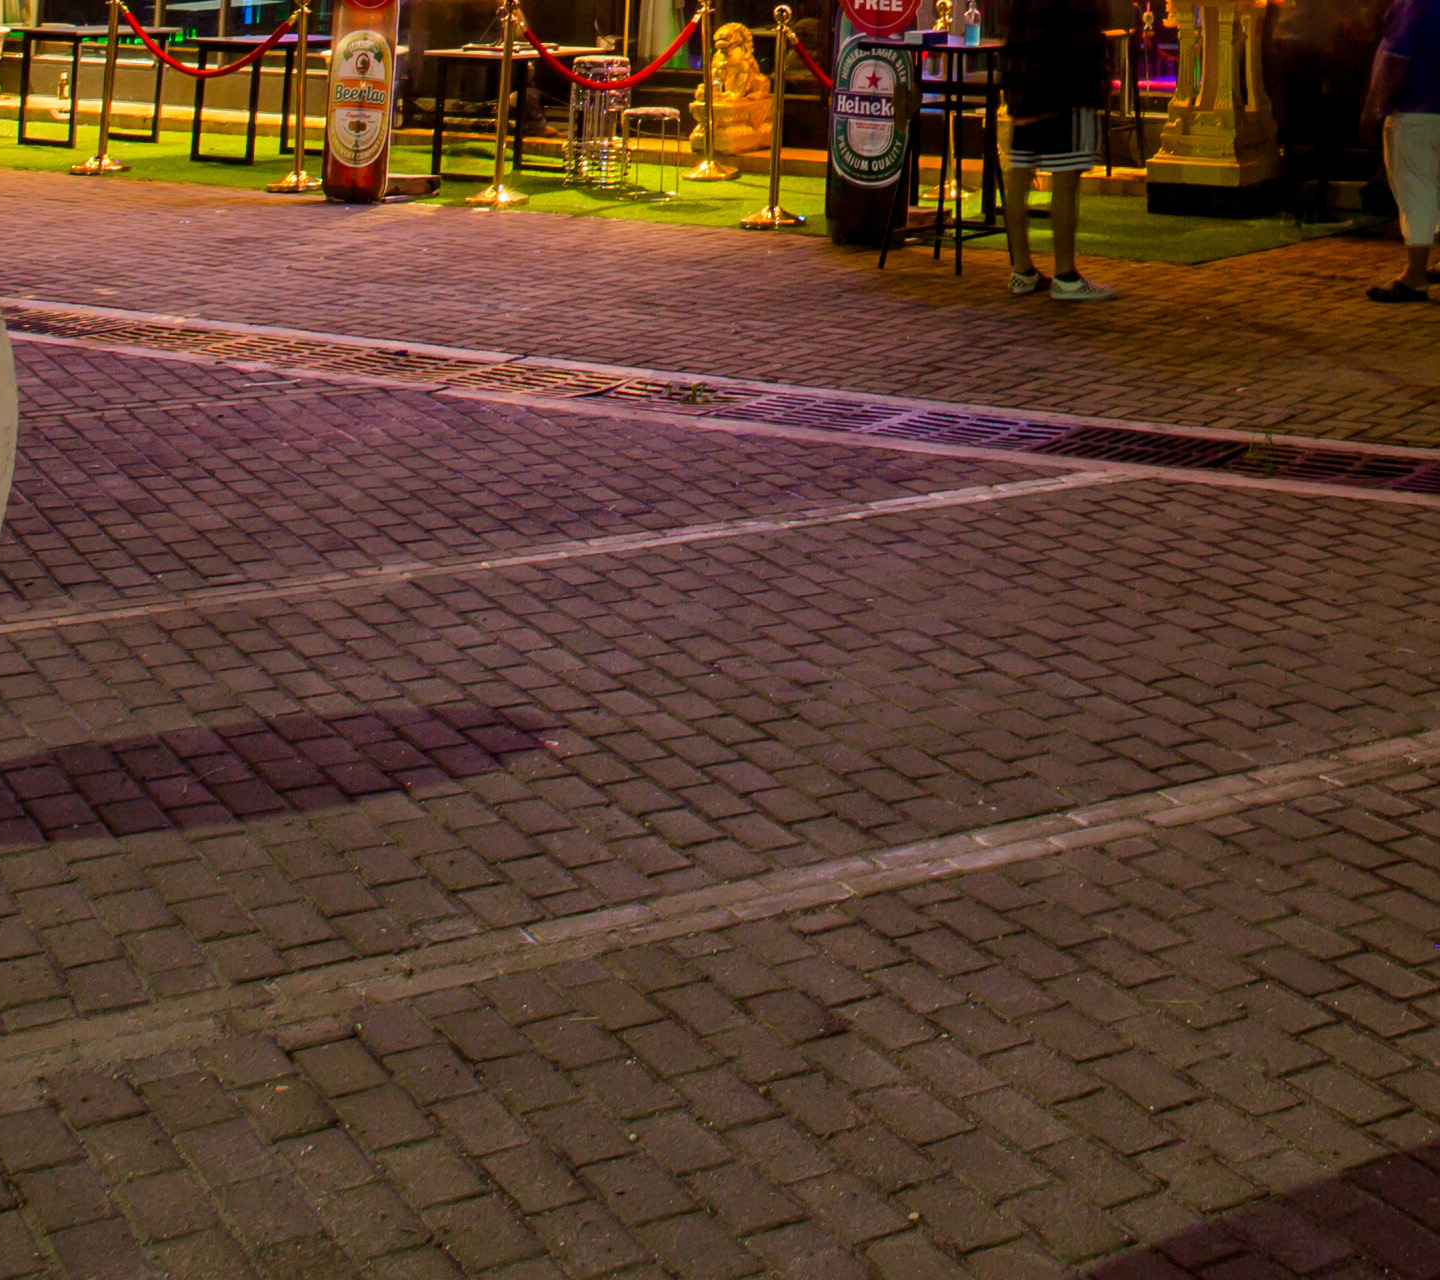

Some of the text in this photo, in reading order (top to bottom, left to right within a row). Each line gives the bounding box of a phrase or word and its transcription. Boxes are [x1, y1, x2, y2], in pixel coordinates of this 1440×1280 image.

[334, 84, 386, 105] Beerlao
[837, 135, 869, 171] PREMIUM
[871, 139, 902, 171] QUALITY
